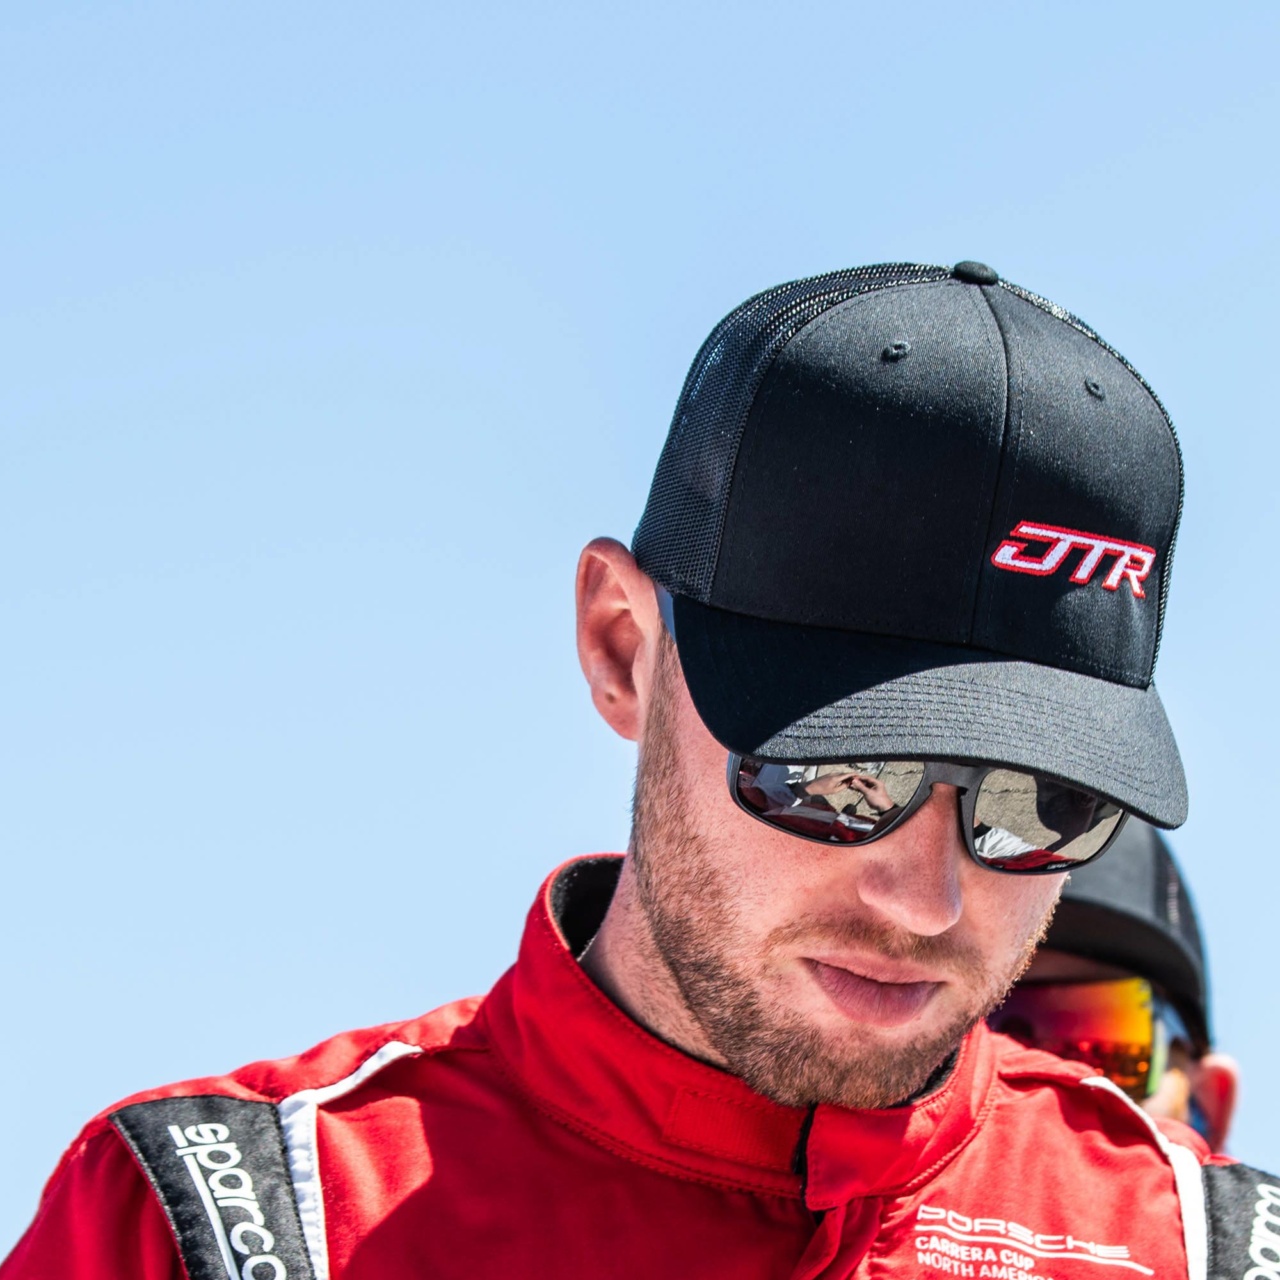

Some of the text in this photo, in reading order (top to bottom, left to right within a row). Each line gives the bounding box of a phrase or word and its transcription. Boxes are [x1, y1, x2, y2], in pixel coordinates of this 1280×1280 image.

[991, 520, 1156, 598] JTR
[915, 1235, 1035, 1272] CARRERA CUP
[916, 1203, 1132, 1260] PORSCHE
[917, 1252, 975, 1278] NORTH
